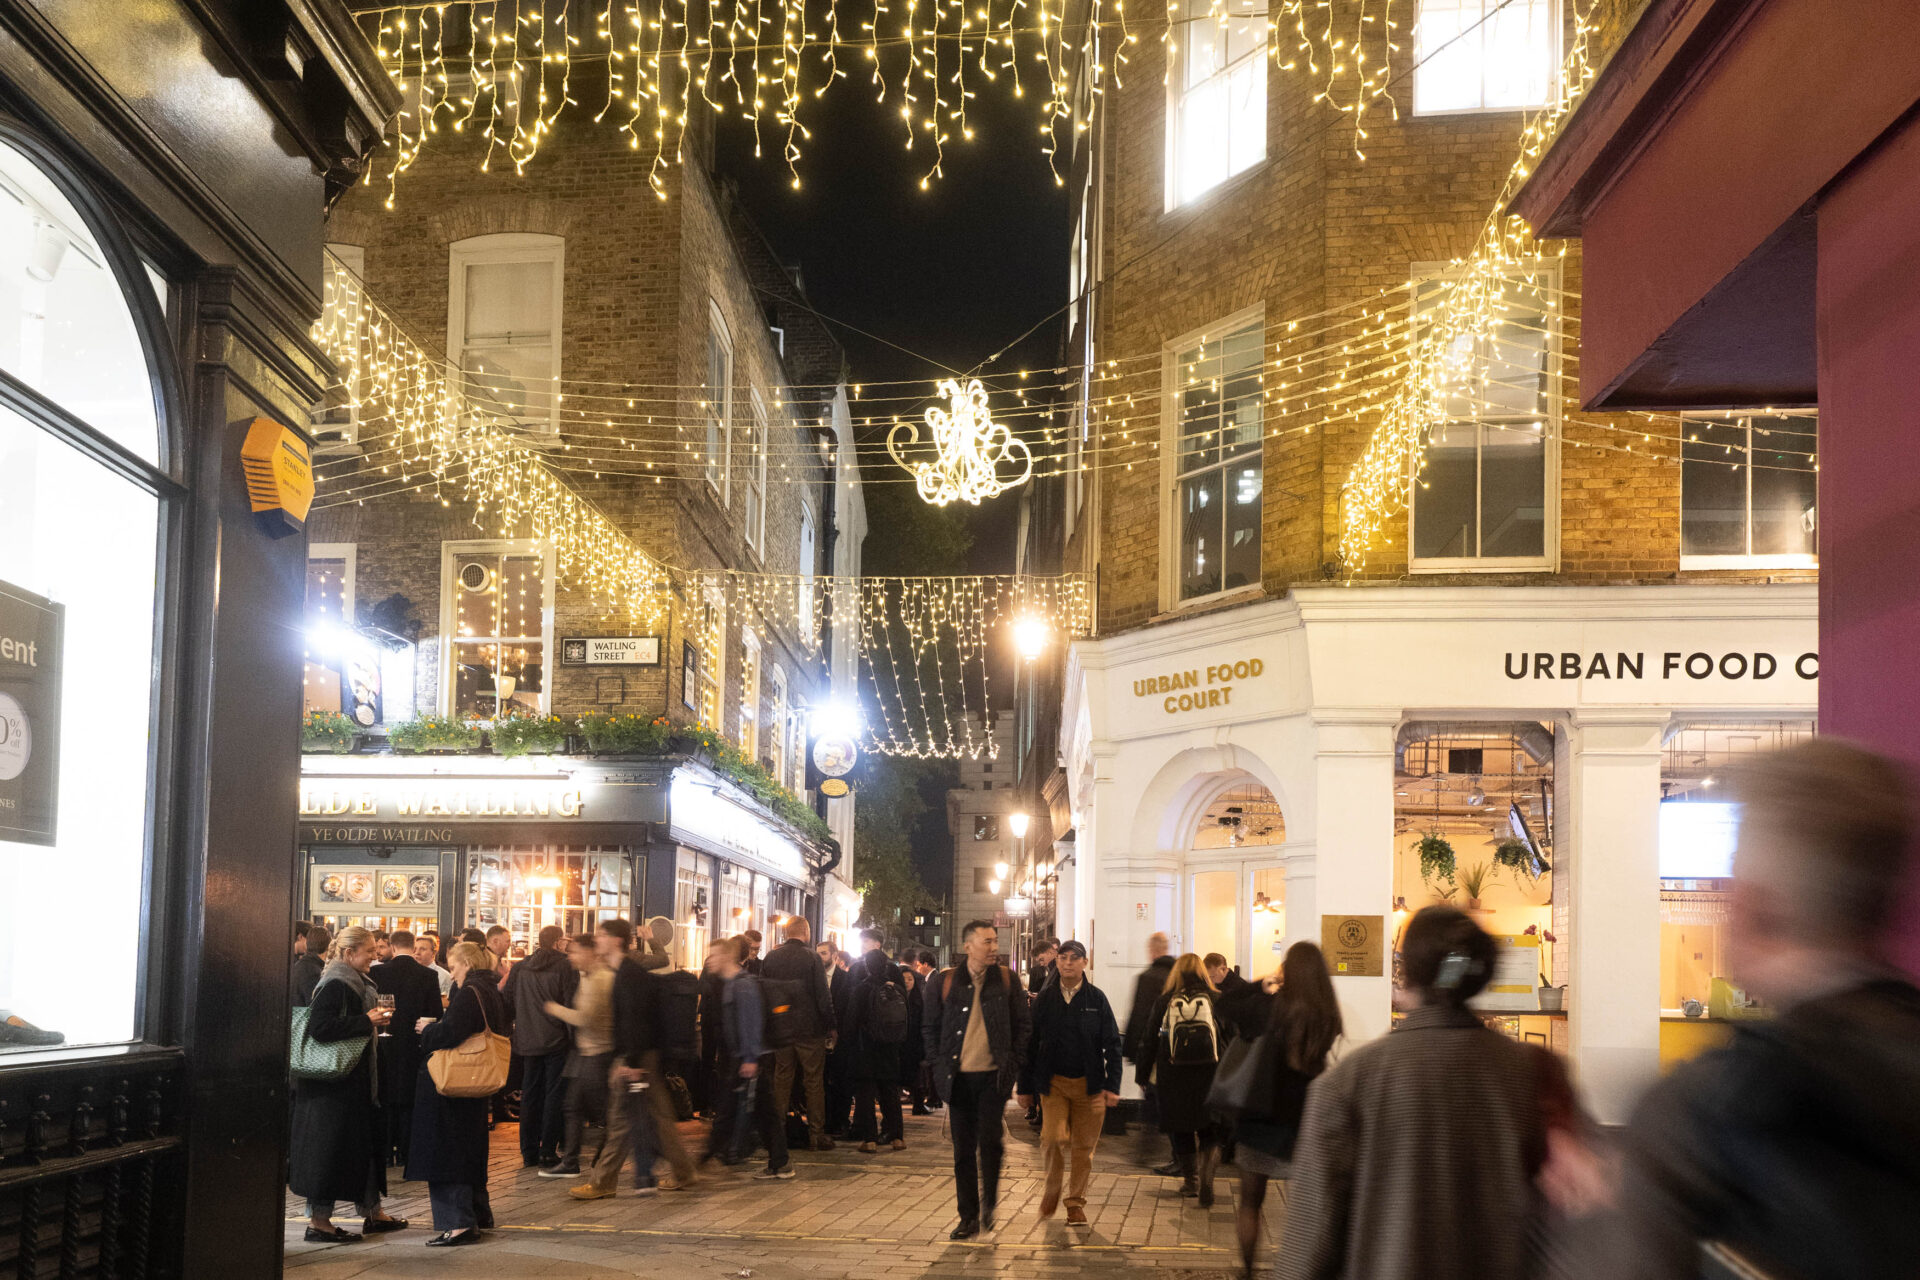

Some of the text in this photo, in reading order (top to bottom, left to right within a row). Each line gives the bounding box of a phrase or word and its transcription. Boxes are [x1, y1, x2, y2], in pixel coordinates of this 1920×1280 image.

[284, 456, 306, 479] STANLEY
[0, 635, 37, 667] ent
[594, 641, 636, 650] WATLING
[594, 651, 626, 660] STREET
[634, 651, 651, 660] EC4
[1133, 658, 1264, 697] URBAN FOOD
[1505, 652, 1644, 680] URBAN
[1662, 652, 1777, 680] FOOD
[1163, 686, 1232, 714] COURT
[397, 791, 584, 817] WATLING
[312, 828, 452, 842] YE OLDE WATLING
